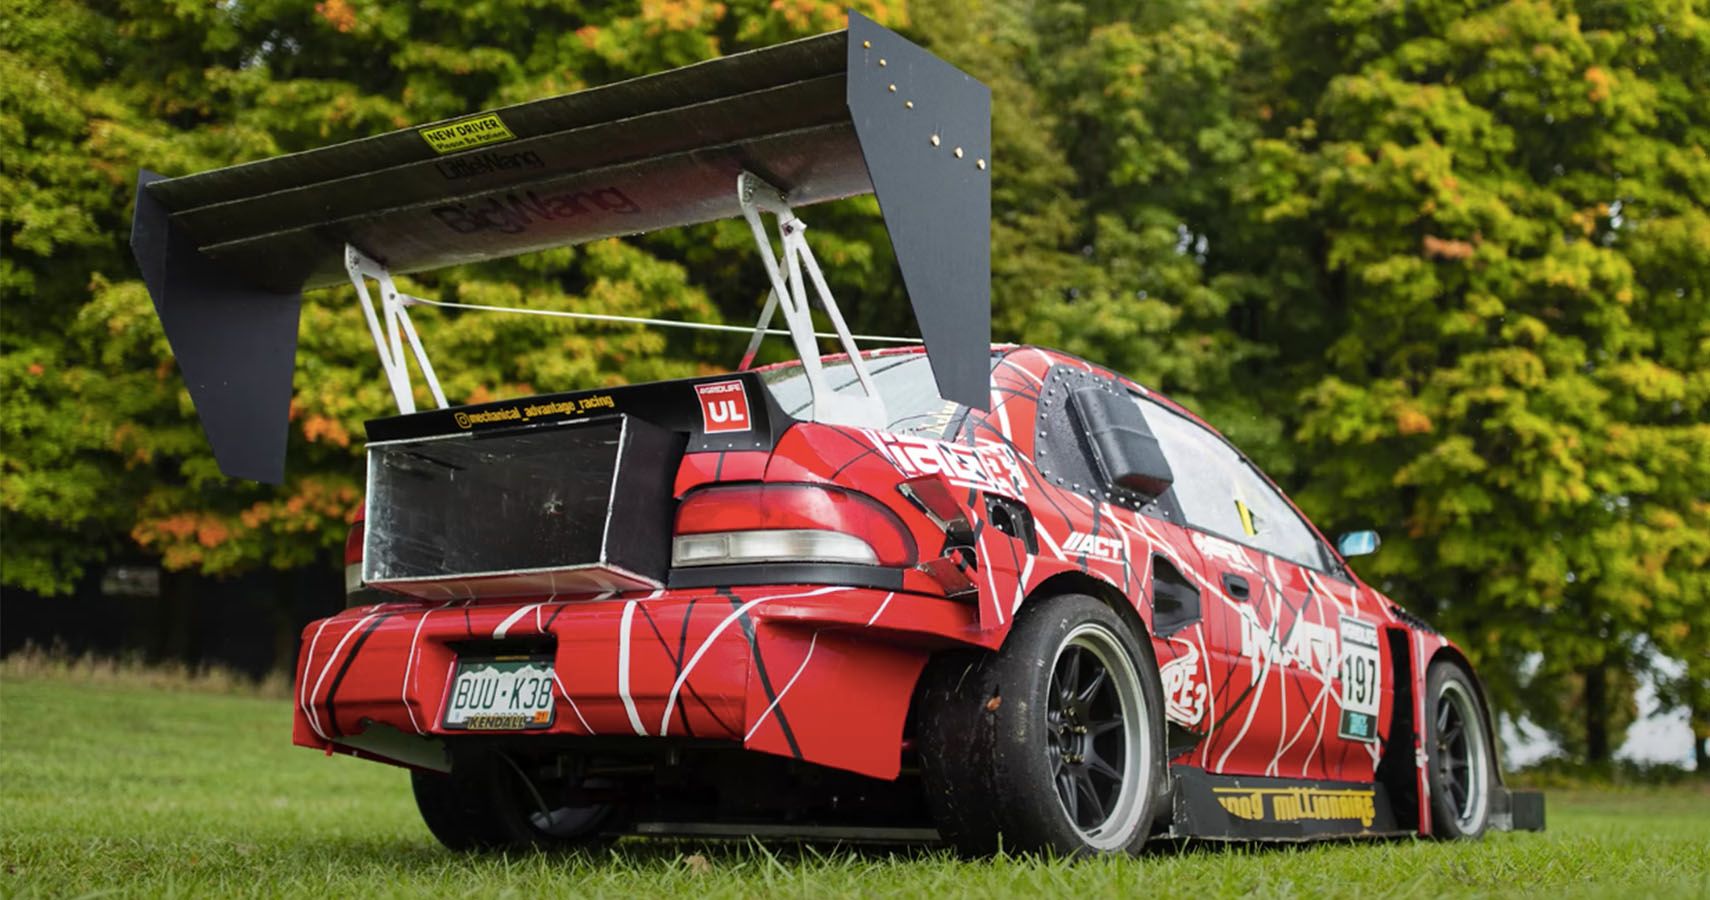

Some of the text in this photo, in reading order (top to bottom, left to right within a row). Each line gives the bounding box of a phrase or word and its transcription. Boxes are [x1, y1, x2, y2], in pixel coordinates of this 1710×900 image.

[427, 118, 500, 142] NEW DRIVER
[436, 140, 465, 149] Please
[476, 130, 508, 142] Patient
[469, 395, 615, 424] mechanical_advantage_racing
[708, 400, 744, 423] UL
[1345, 653, 1376, 706] 197
[469, 714, 526, 729] KENDALL
